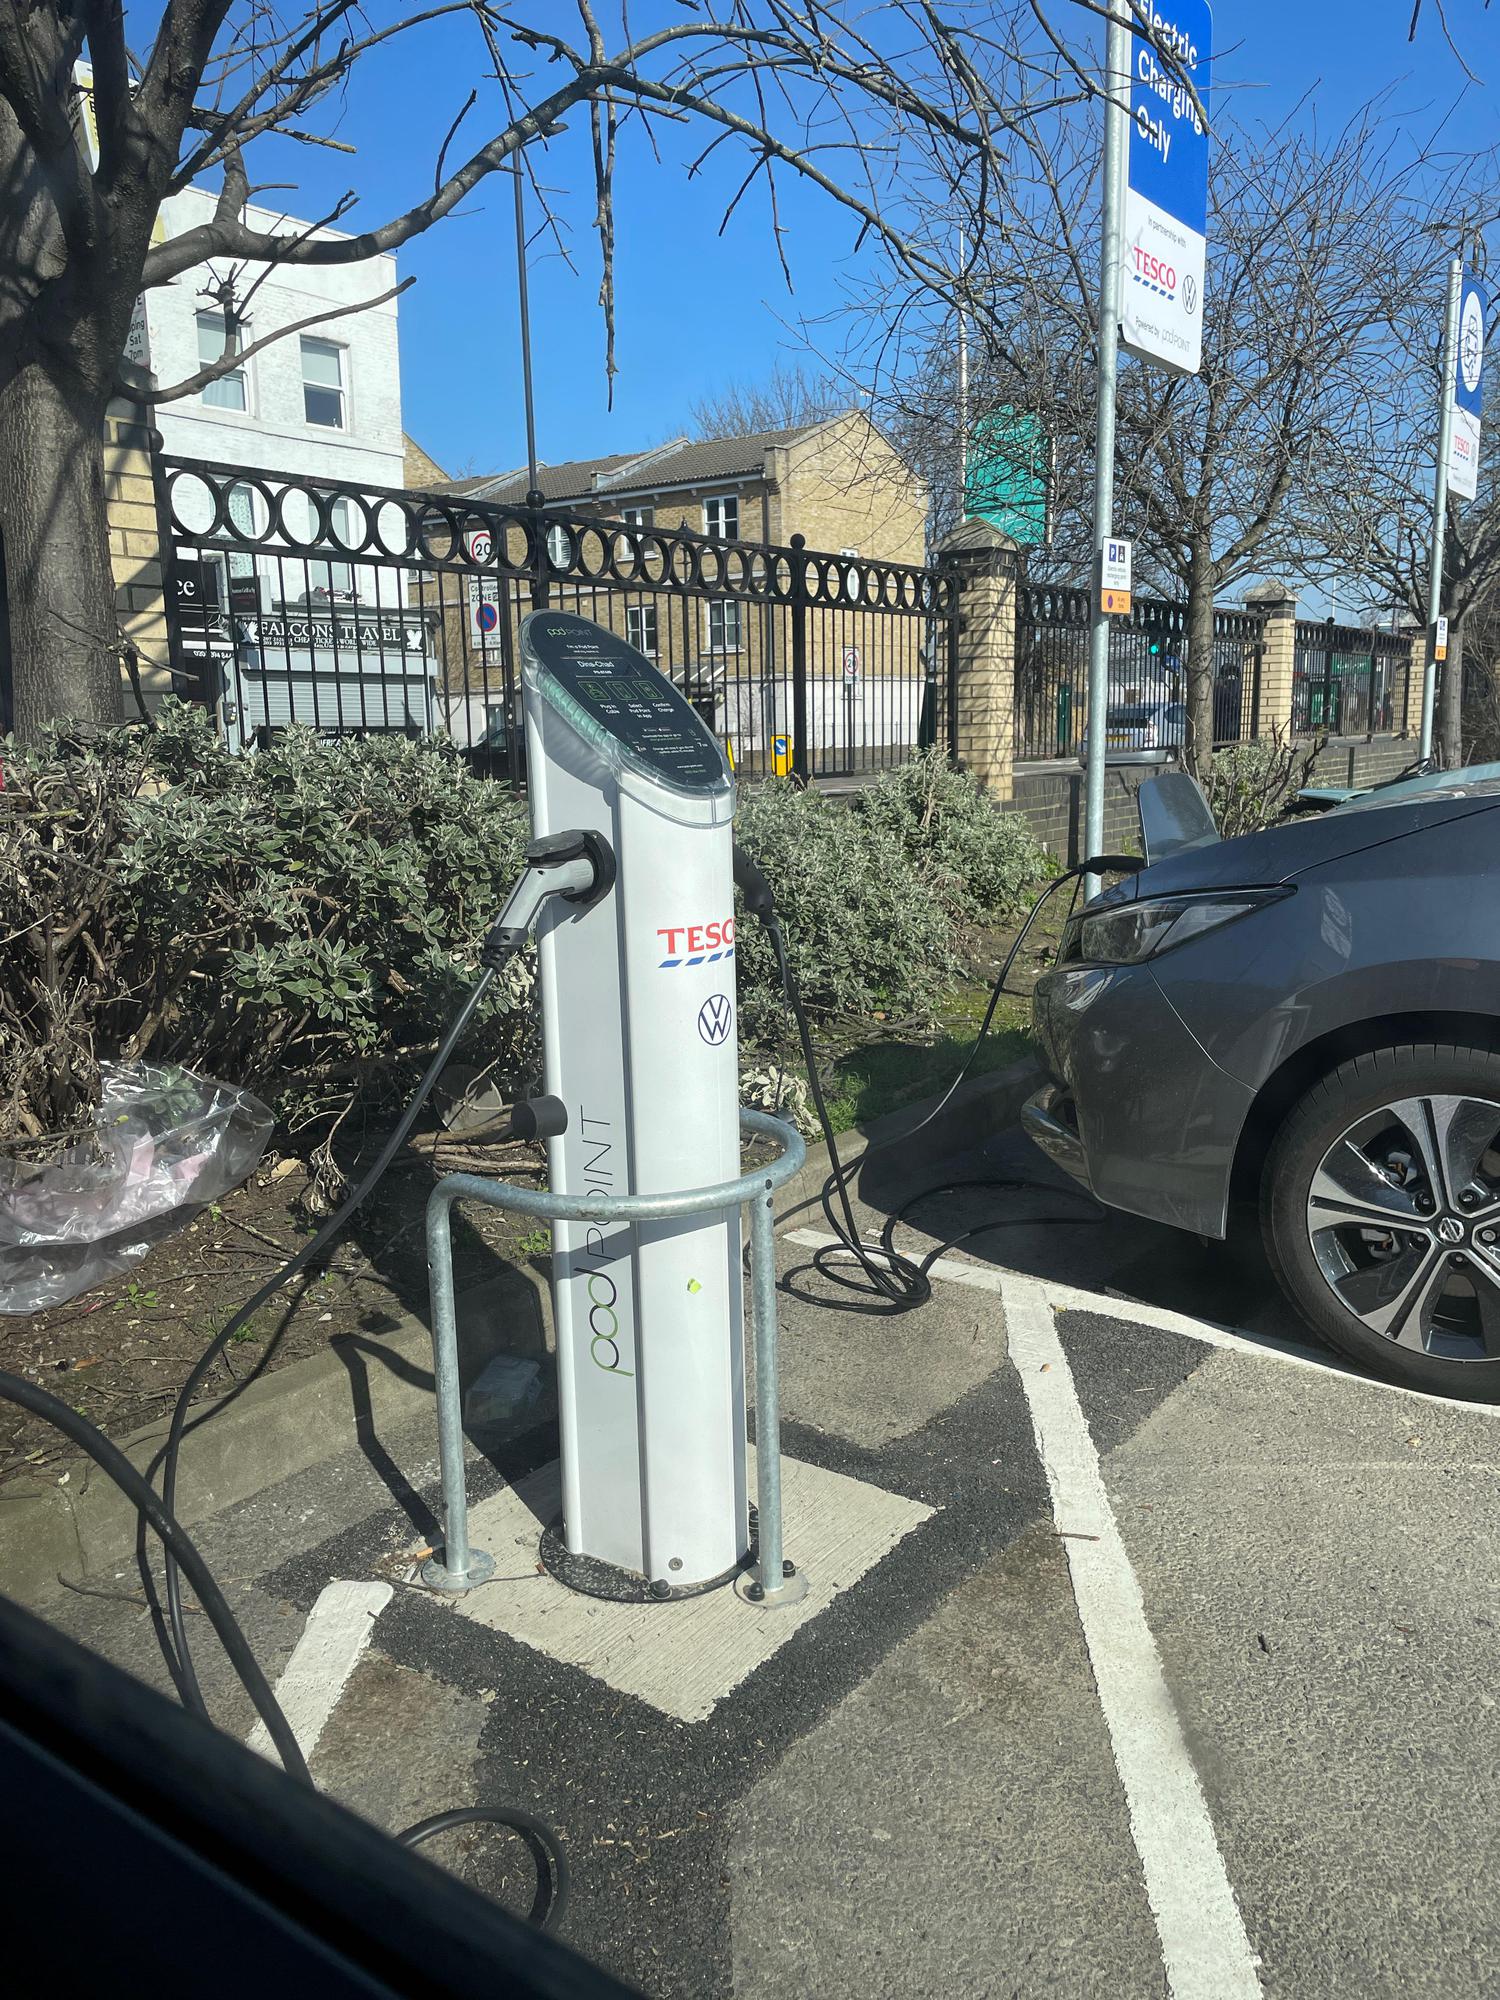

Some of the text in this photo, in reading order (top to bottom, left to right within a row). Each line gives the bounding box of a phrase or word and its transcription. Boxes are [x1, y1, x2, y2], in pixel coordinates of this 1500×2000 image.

[1138, 50, 1203, 135] Charging
[1137, 105, 1171, 163] Only
[1134, 247, 1176, 290] TESCO
[1454, 435, 1470, 455] TESCO
[261, 621, 333, 638] FALCONS
[657, 915, 736, 954] TESC
